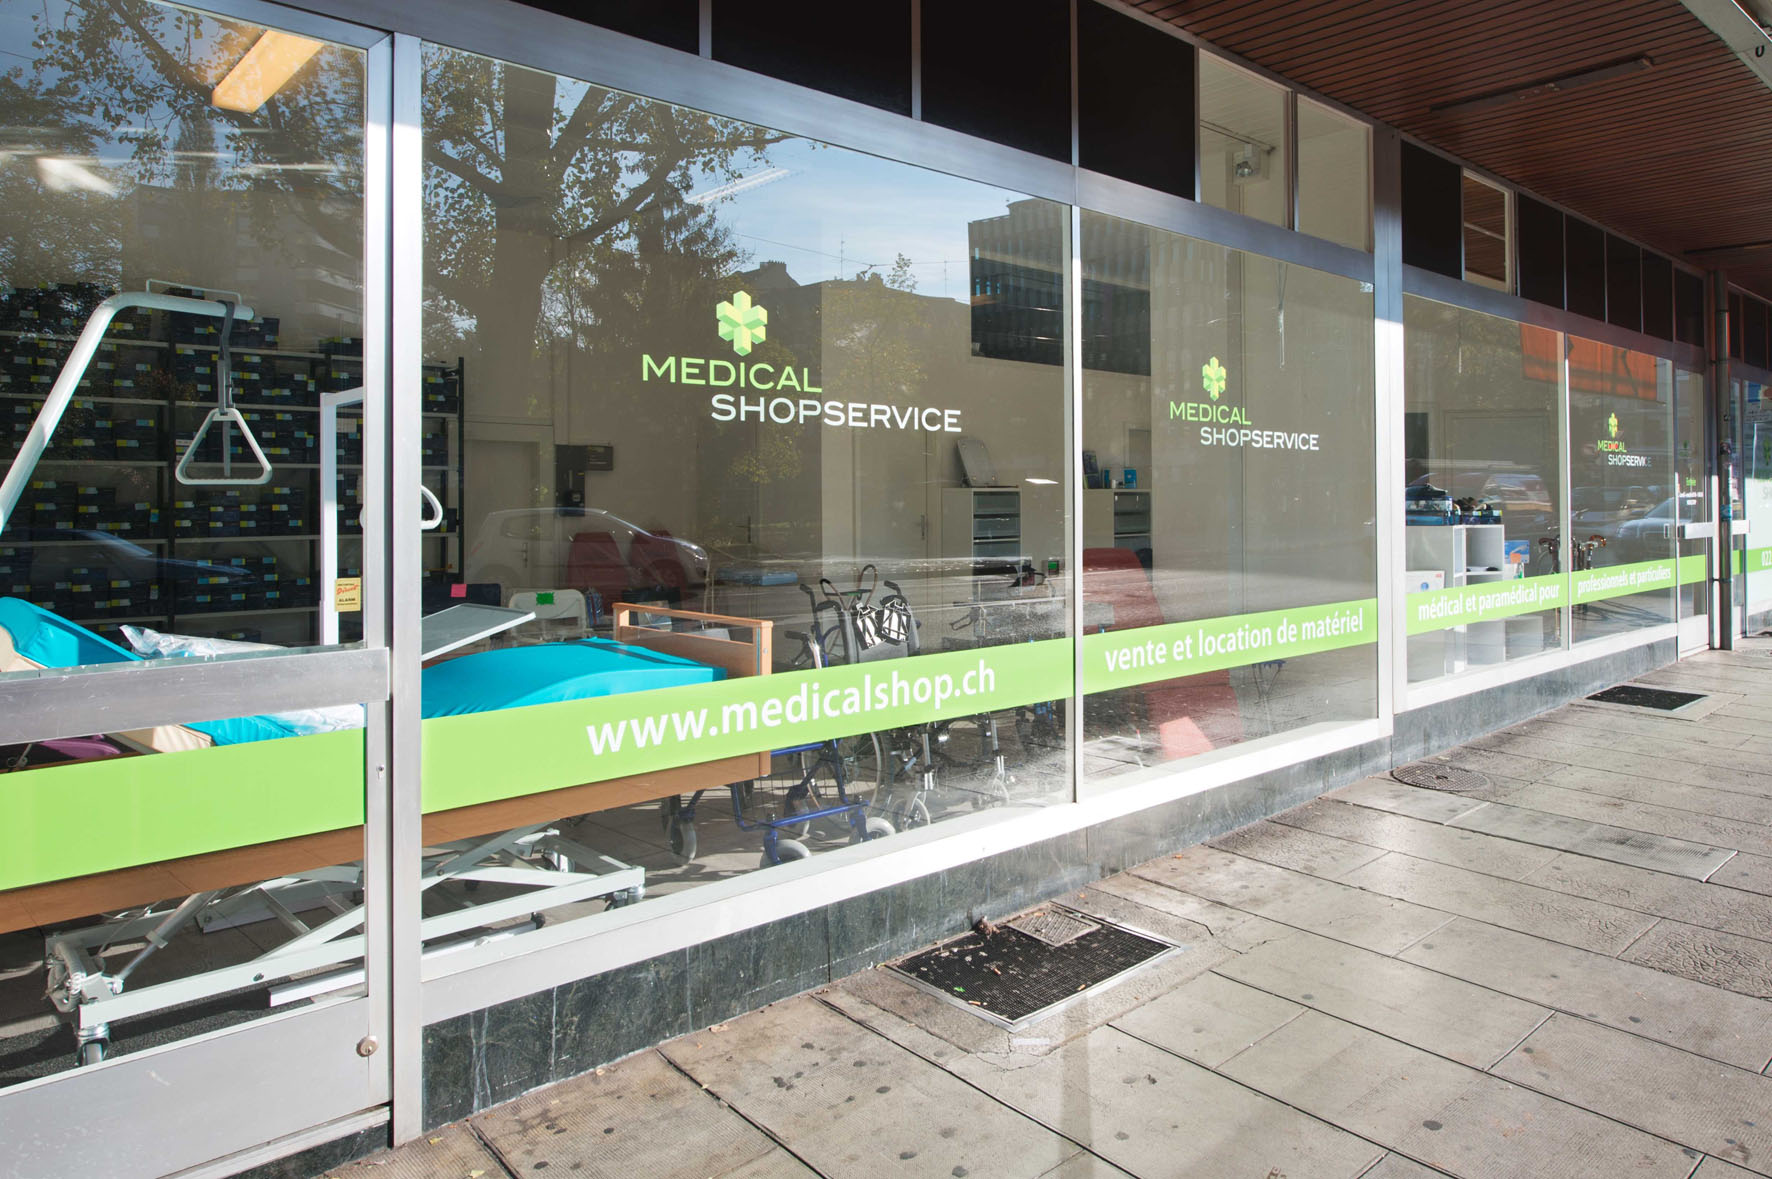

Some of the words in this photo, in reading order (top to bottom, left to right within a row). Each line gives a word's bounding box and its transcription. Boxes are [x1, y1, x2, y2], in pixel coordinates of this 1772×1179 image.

[641, 353, 823, 393] MEDICAL
[711, 393, 962, 433] SHOPSERVICE
[1169, 400, 1252, 425] MEDICAL
[1200, 426, 1320, 451] SHOPSERVICE
[1597, 439, 1627, 453] MEDICAL
[1418, 592, 1463, 622] médical
[1465, 593, 1476, 612] et
[1478, 582, 1538, 616] paramédical
[1539, 583, 1560, 606] pour
[1577, 569, 1629, 599] professionnels
[1629, 570, 1637, 585] et
[1637, 565, 1671, 588] particuliers
[1105, 640, 1167, 672] vente
[1172, 633, 1194, 661] et
[1198, 624, 1273, 657] location
[1276, 617, 1298, 645] de
[1301, 607, 1363, 641] matériel
[586, 659, 996, 756] www.medicalshop.ch
